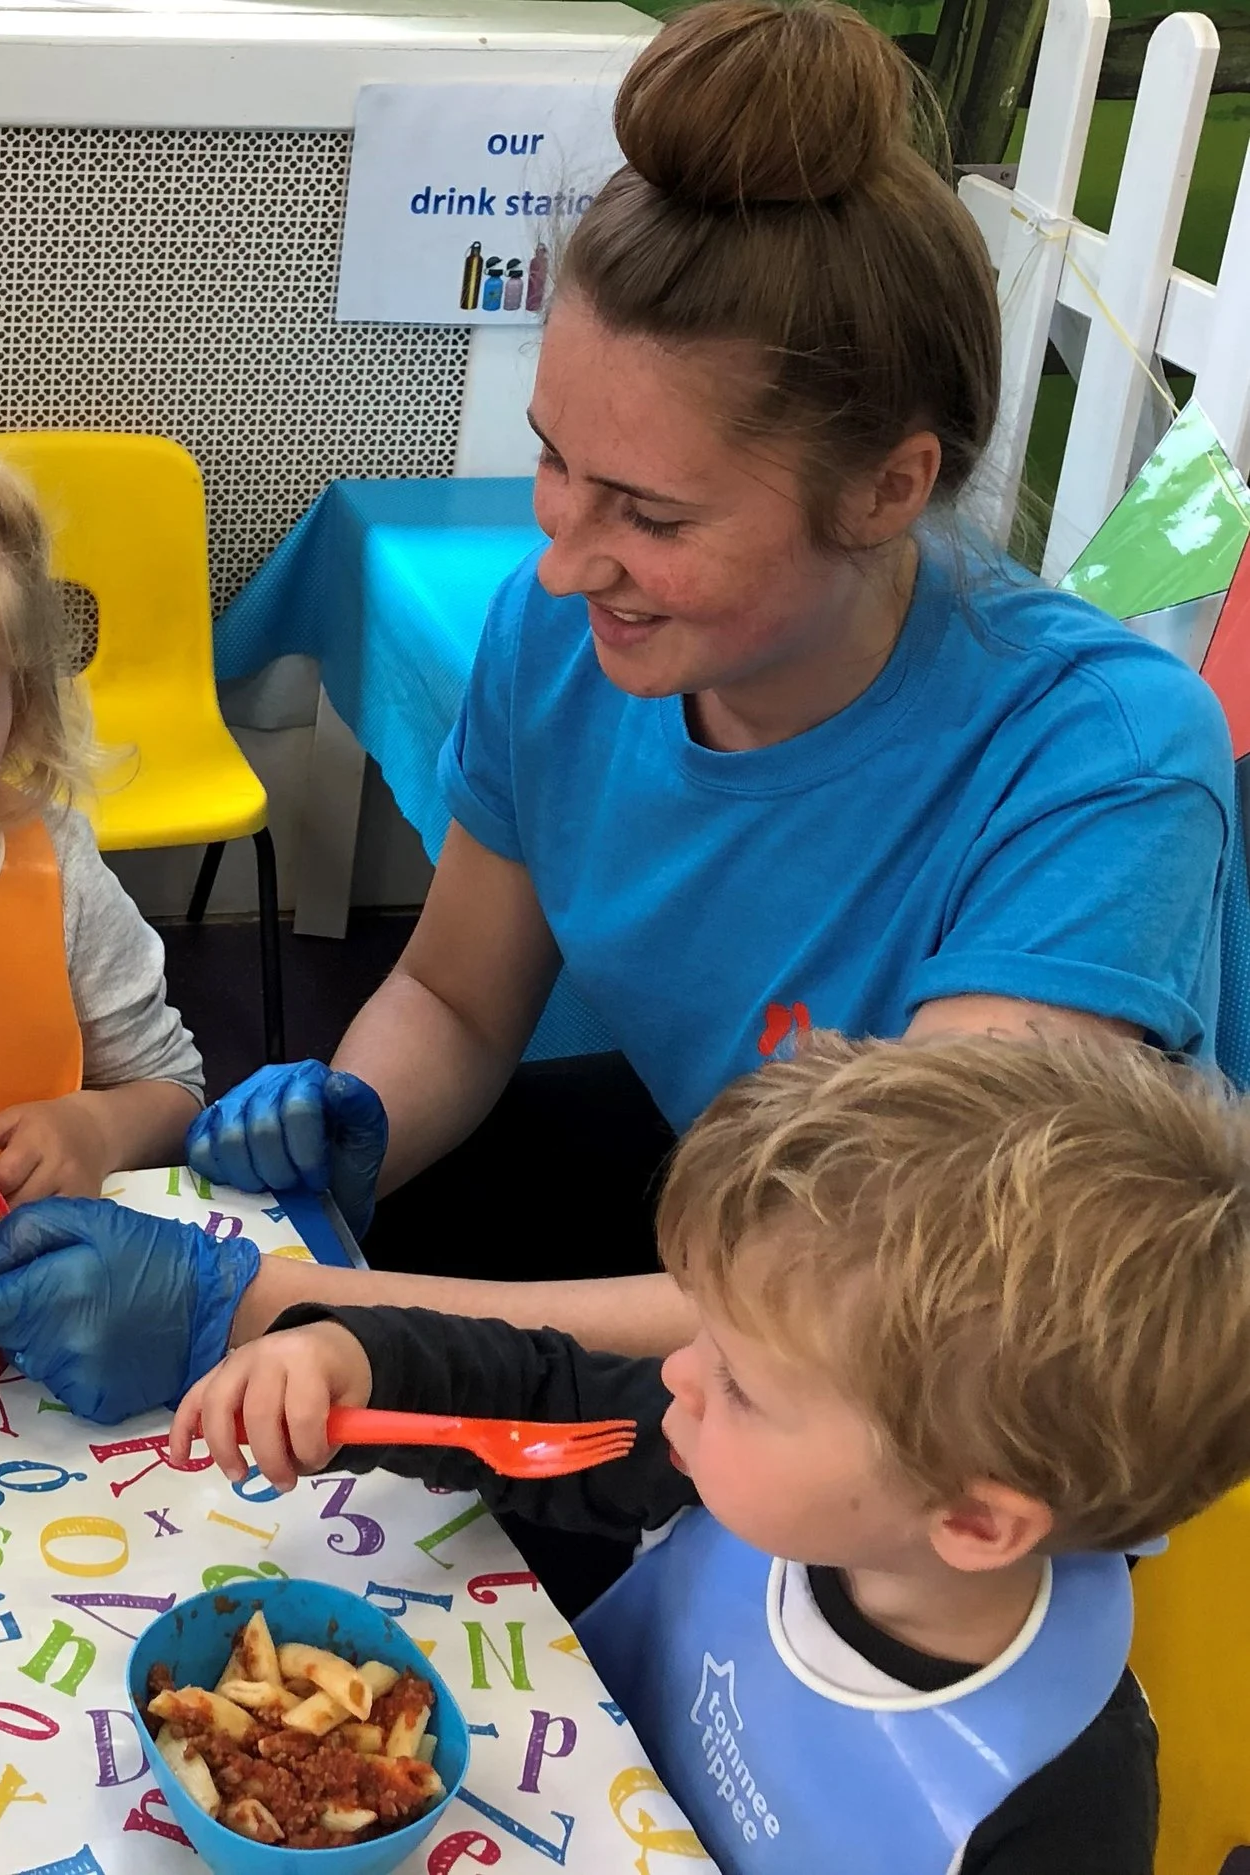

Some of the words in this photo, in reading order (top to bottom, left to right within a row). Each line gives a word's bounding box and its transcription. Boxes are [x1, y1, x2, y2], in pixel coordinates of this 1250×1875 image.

[487, 133, 544, 155] our
[410, 186, 496, 216] drink
[505, 188, 594, 216] statio
[462, 1620, 535, 1692] N
[701, 1725, 758, 1844] tippee
[708, 1691, 780, 1839] tommee
